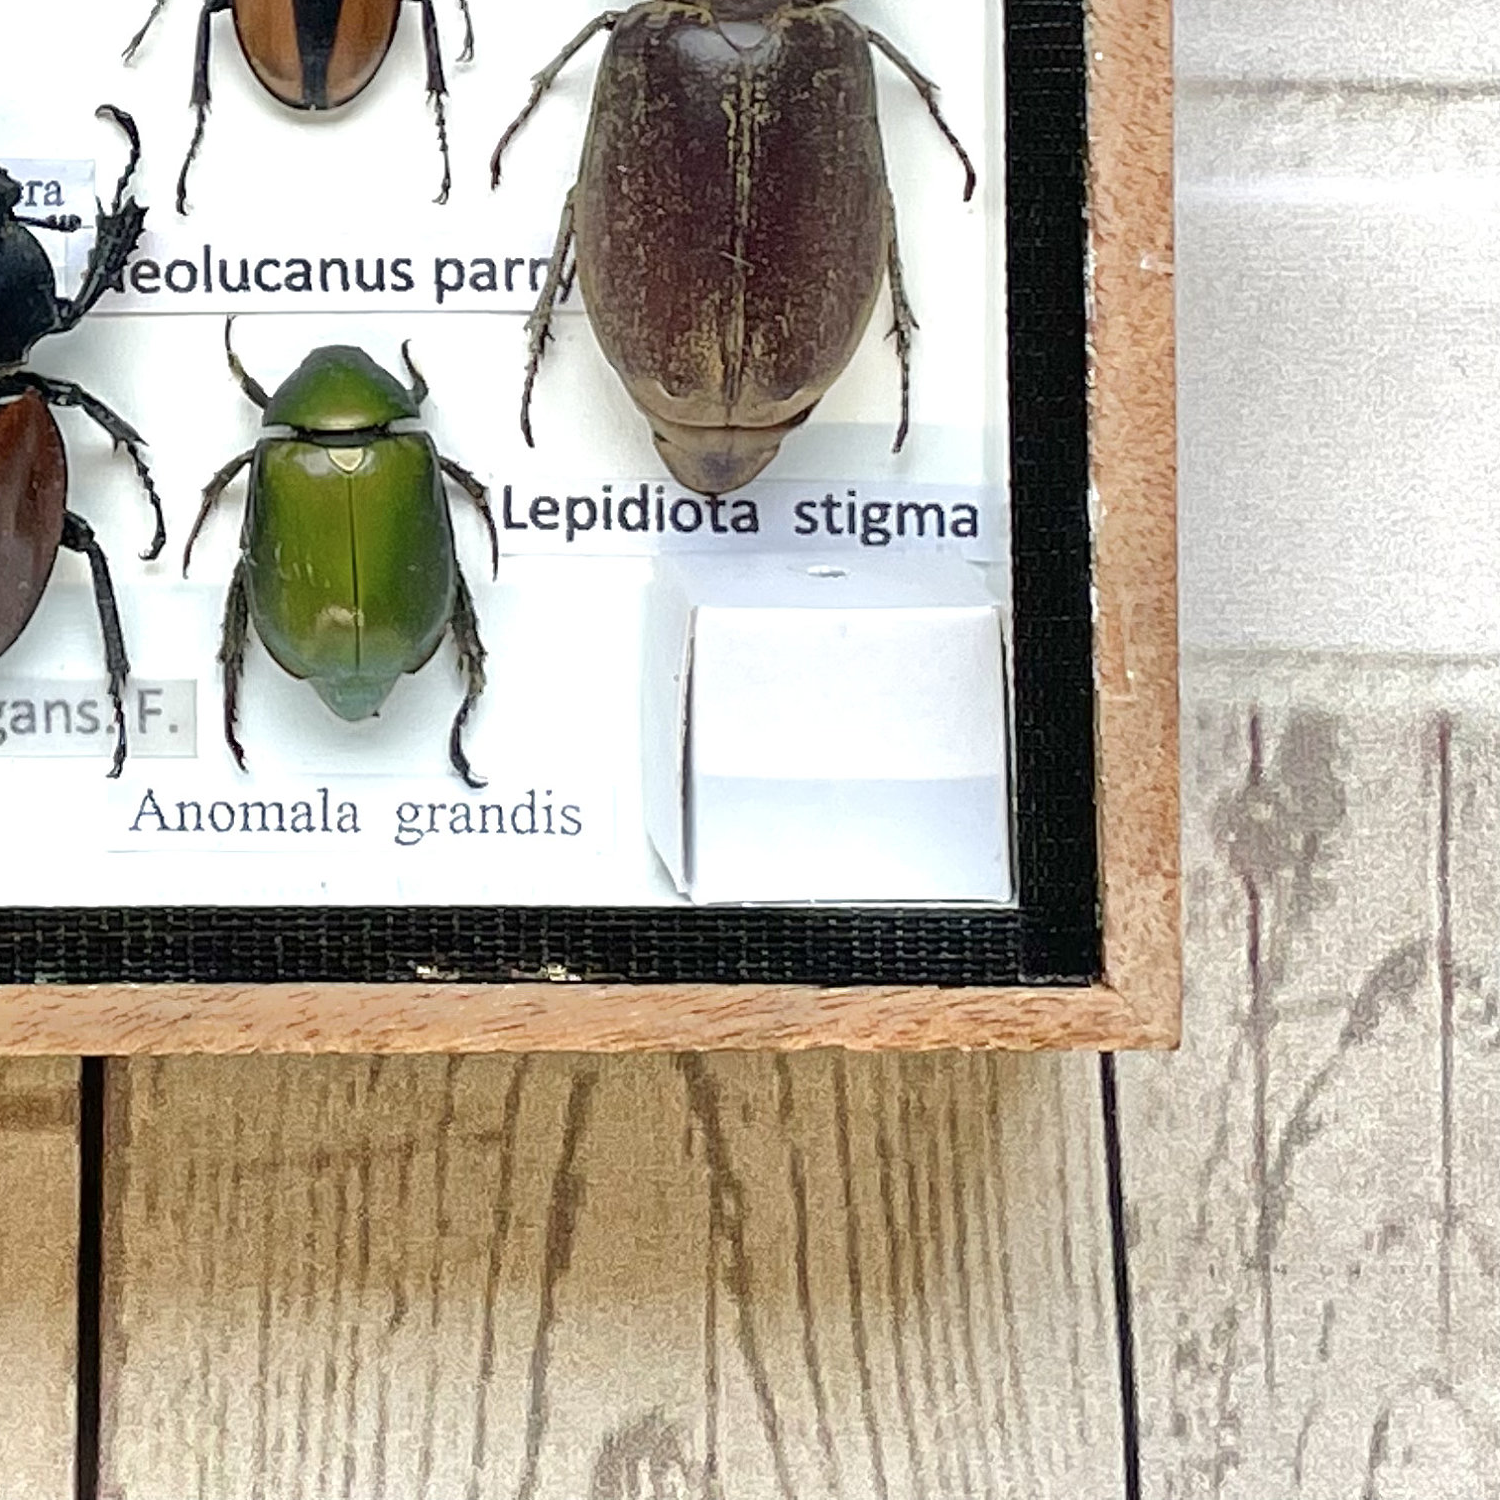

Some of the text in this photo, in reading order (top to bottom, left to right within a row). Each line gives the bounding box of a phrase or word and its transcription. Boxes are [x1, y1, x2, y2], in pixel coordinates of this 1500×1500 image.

[122, 243, 415, 294] eolucanus
[501, 483, 980, 547] Lepidiota stigma
[136, 687, 180, 735] F.
[127, 787, 584, 846] Anomala grandis
